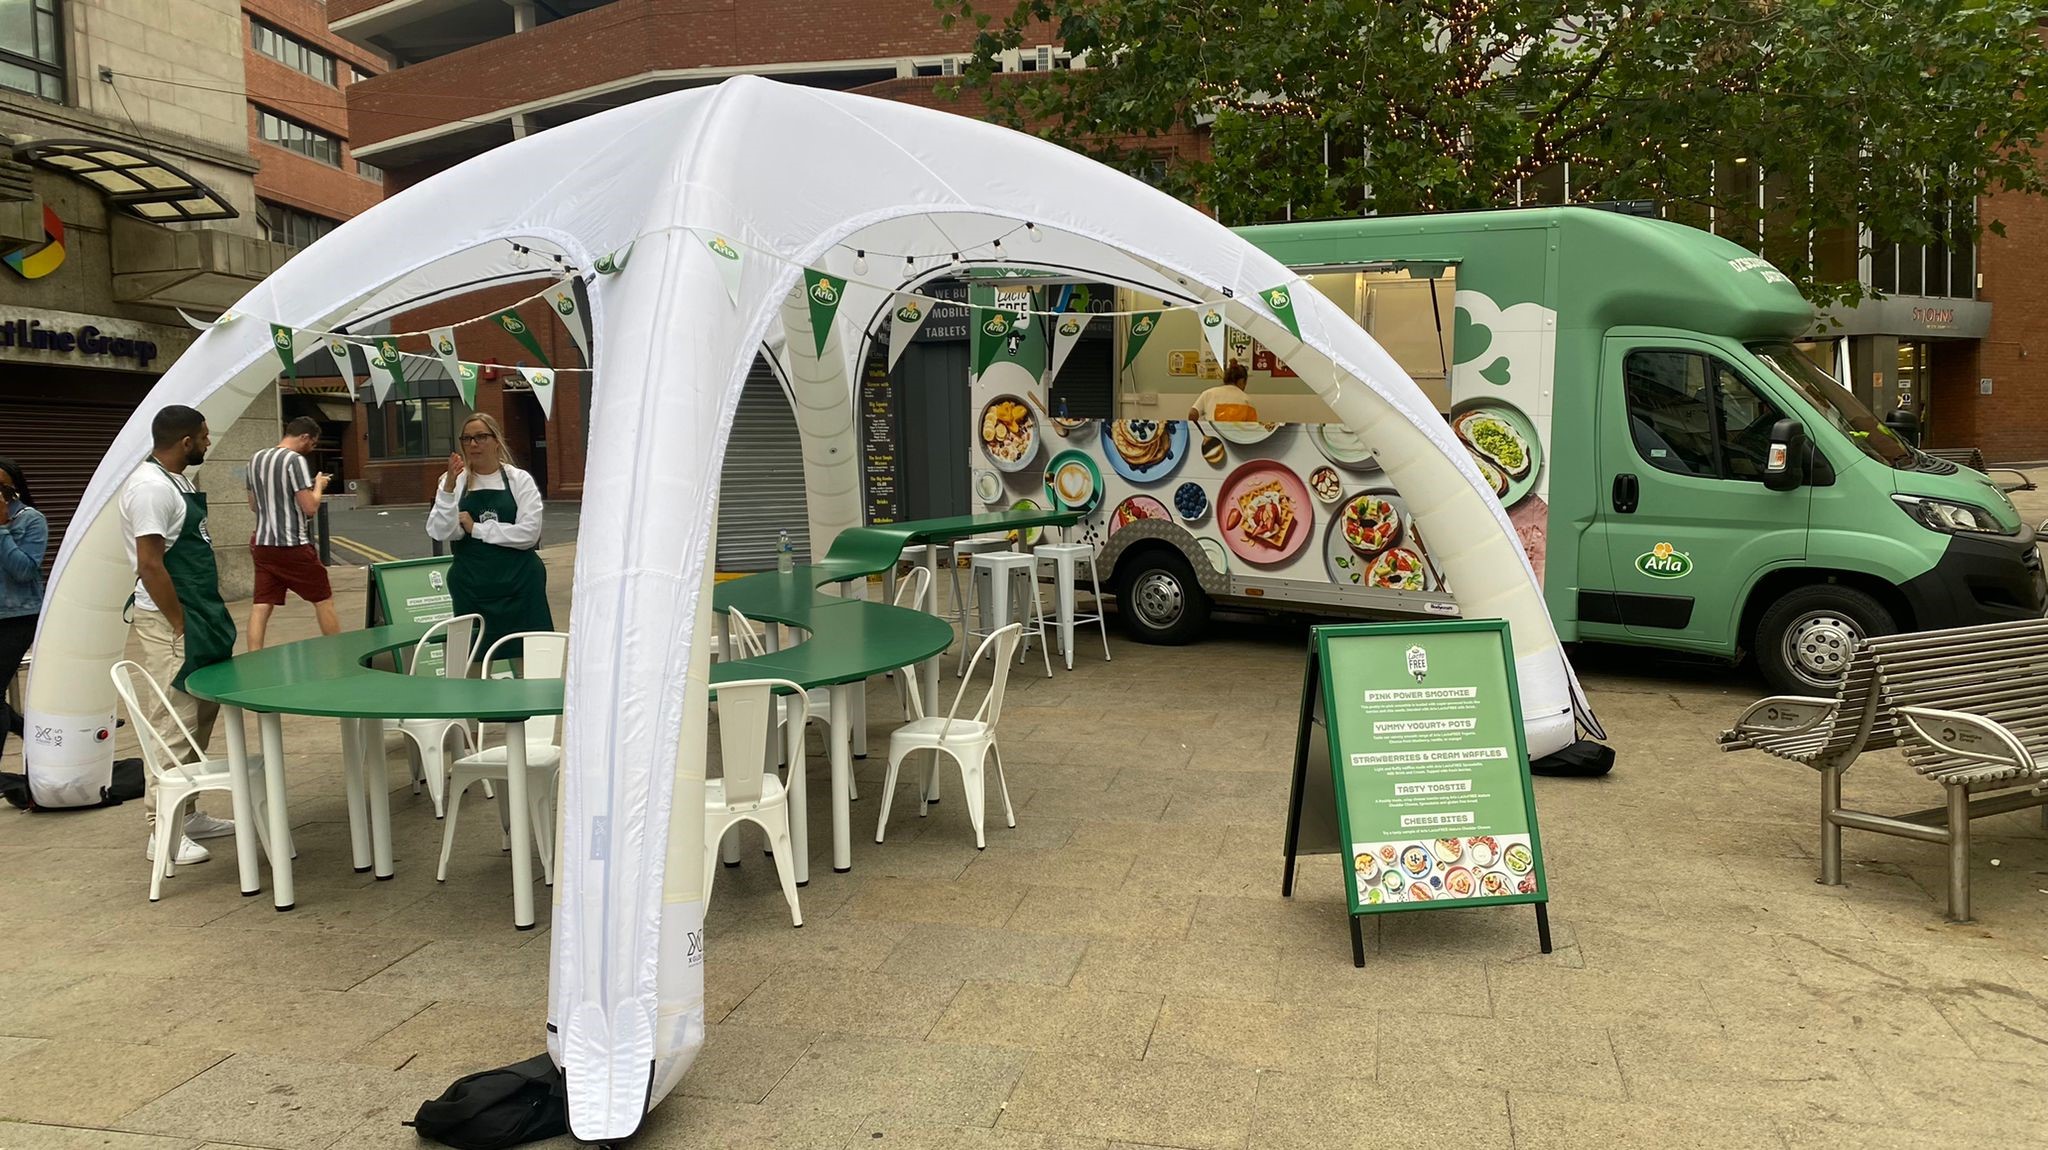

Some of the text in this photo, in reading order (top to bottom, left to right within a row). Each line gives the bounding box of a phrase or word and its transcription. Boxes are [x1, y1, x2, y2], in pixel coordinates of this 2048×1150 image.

[712, 242, 736, 258] Arla
[815, 288, 835, 301] Arla
[899, 308, 919, 320] Arla
[932, 307, 970, 319] MOBILE
[925, 325, 967, 338] TABLETS
[987, 322, 1004, 333] Arla
[1061, 325, 1079, 333] Arla
[18, 319, 75, 352] Line
[78, 325, 157, 367] Group
[1645, 556, 1682, 572] Arla
[1409, 659, 1426, 670] FREE
[1368, 688, 1470, 701] PINK POWER SMOOTHIE
[1375, 720, 1471, 731] YUMMY YOGURT+ POTS
[1353, 752, 1421, 765] STRAWBERRIES
[1431, 751, 1460, 760] CREAM
[1462, 749, 1502, 758] WAFFLES
[1397, 783, 1467, 794] TASTY TOASTIE
[1404, 815, 1468, 826] CHEESE BITES
